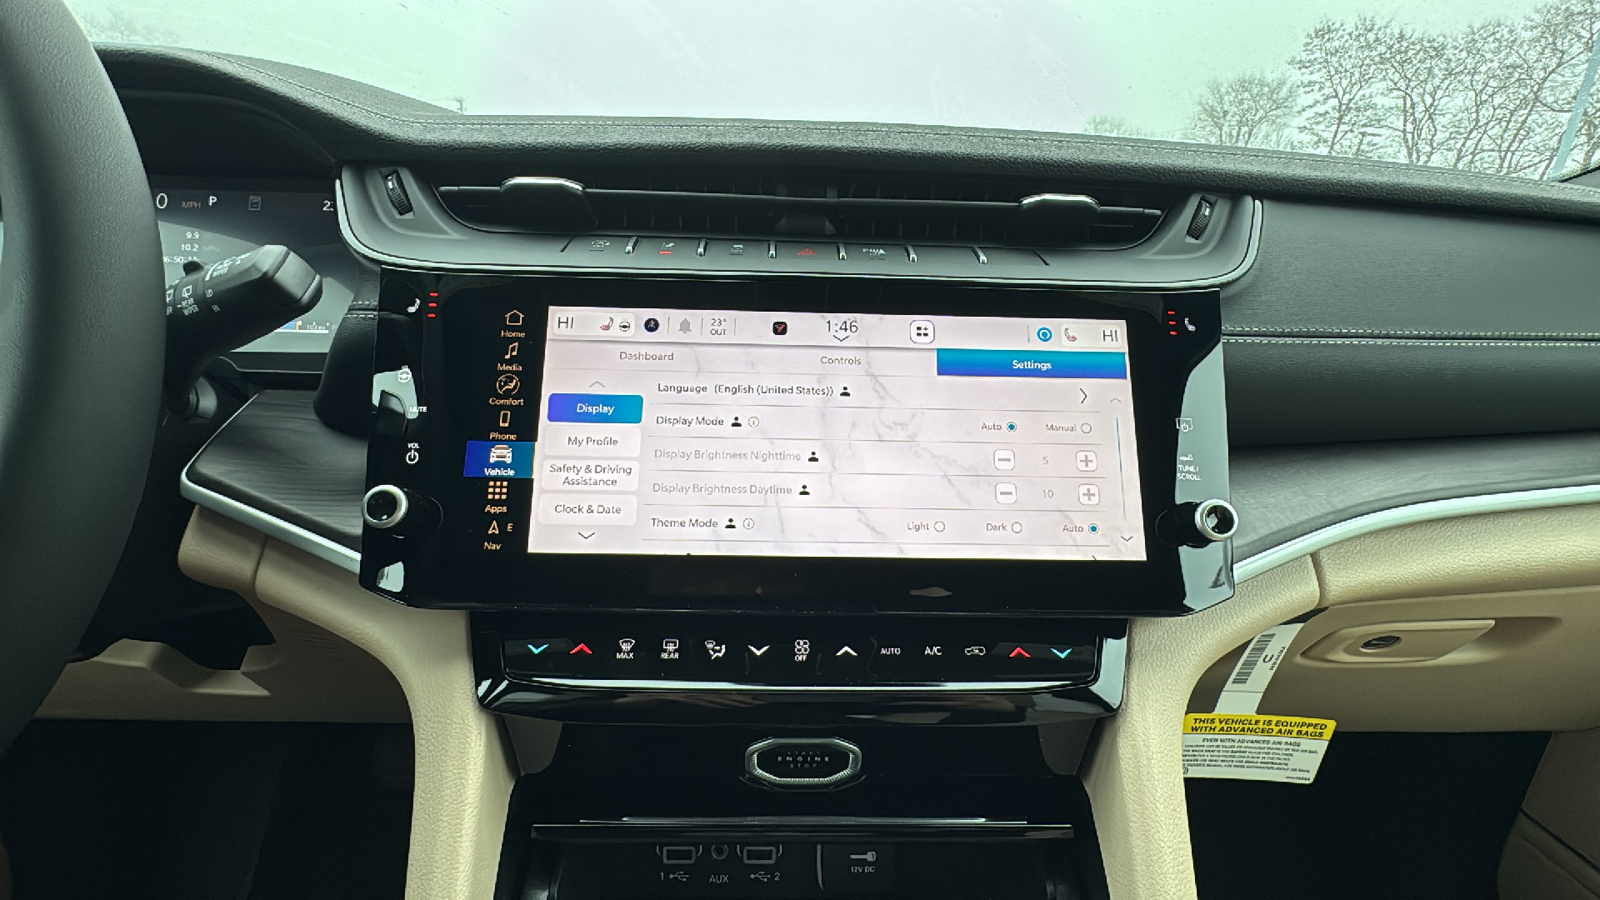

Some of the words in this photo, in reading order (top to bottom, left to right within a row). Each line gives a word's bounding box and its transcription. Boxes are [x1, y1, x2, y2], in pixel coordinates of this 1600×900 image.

[181, 201, 202, 209] MPH
[208, 195, 218, 207] P
[186, 231, 200, 240] 9.9
[181, 243, 199, 252] 10.2
[557, 317, 574, 329] HI
[710, 318, 727, 327] 23°
[826, 320, 859, 333] 1:46
[500, 329, 526, 338] Home
[710, 328, 727, 336] OUT
[1102, 329, 1119, 343] HI
[619, 351, 674, 361] Dashboard
[820, 356, 862, 366] Controls
[1012, 359, 1053, 371] Settings
[497, 363, 523, 372] Media
[657, 383, 708, 395] Language
[714, 384, 754, 396] (English
[756, 385, 794, 396] (United
[795, 386, 834, 397] States))
[489, 396, 524, 406] Comfort
[409, 405, 428, 413] MUTE
[576, 403, 615, 415] Display
[656, 416, 694, 427] Display
[696, 416, 724, 426] Mode
[981, 422, 1002, 431] Auto
[1045, 423, 1077, 433] Manual
[489, 431, 517, 440] Phone
[568, 437, 586, 447] My
[588, 437, 619, 446] Profile
[654, 449, 691, 460] Display
[694, 450, 748, 461] Brightness
[750, 451, 801, 461] Nighttime
[1043, 456, 1049, 465] 5
[484, 468, 515, 476] Vehicle
[549, 464, 583, 475] Safety
[585, 465, 593, 474] &
[594, 465, 632, 476] Driving
[562, 477, 617, 486] Assistance
[1177, 473, 1201, 481] SCROLL
[652, 483, 691, 494] Display
[693, 484, 747, 495] Brightness
[749, 485, 792, 495] Daytime
[1042, 490, 1054, 499] 10
[484, 504, 508, 514] Apps
[554, 505, 584, 514] Clock
[586, 505, 594, 514] &
[596, 505, 622, 514] Date
[507, 523, 513, 532] E
[651, 518, 686, 527] Theme
[688, 518, 718, 528] Mode
[907, 522, 930, 532] Light
[986, 523, 1008, 532] Dark
[1062, 524, 1084, 533] Auto
[483, 541, 502, 550] Nav
[880, 647, 901, 655] AUTO
[924, 646, 942, 656] A/C
[1218, 718, 1261, 726] VEHICLE
[1275, 720, 1327, 730] EQUIPPED
[1276, 728, 1293, 736] AIR
[1296, 730, 1324, 738] BAGS
[660, 872, 664, 881] 1
[709, 875, 729, 883] AUX
[774, 872, 781, 881] 2
